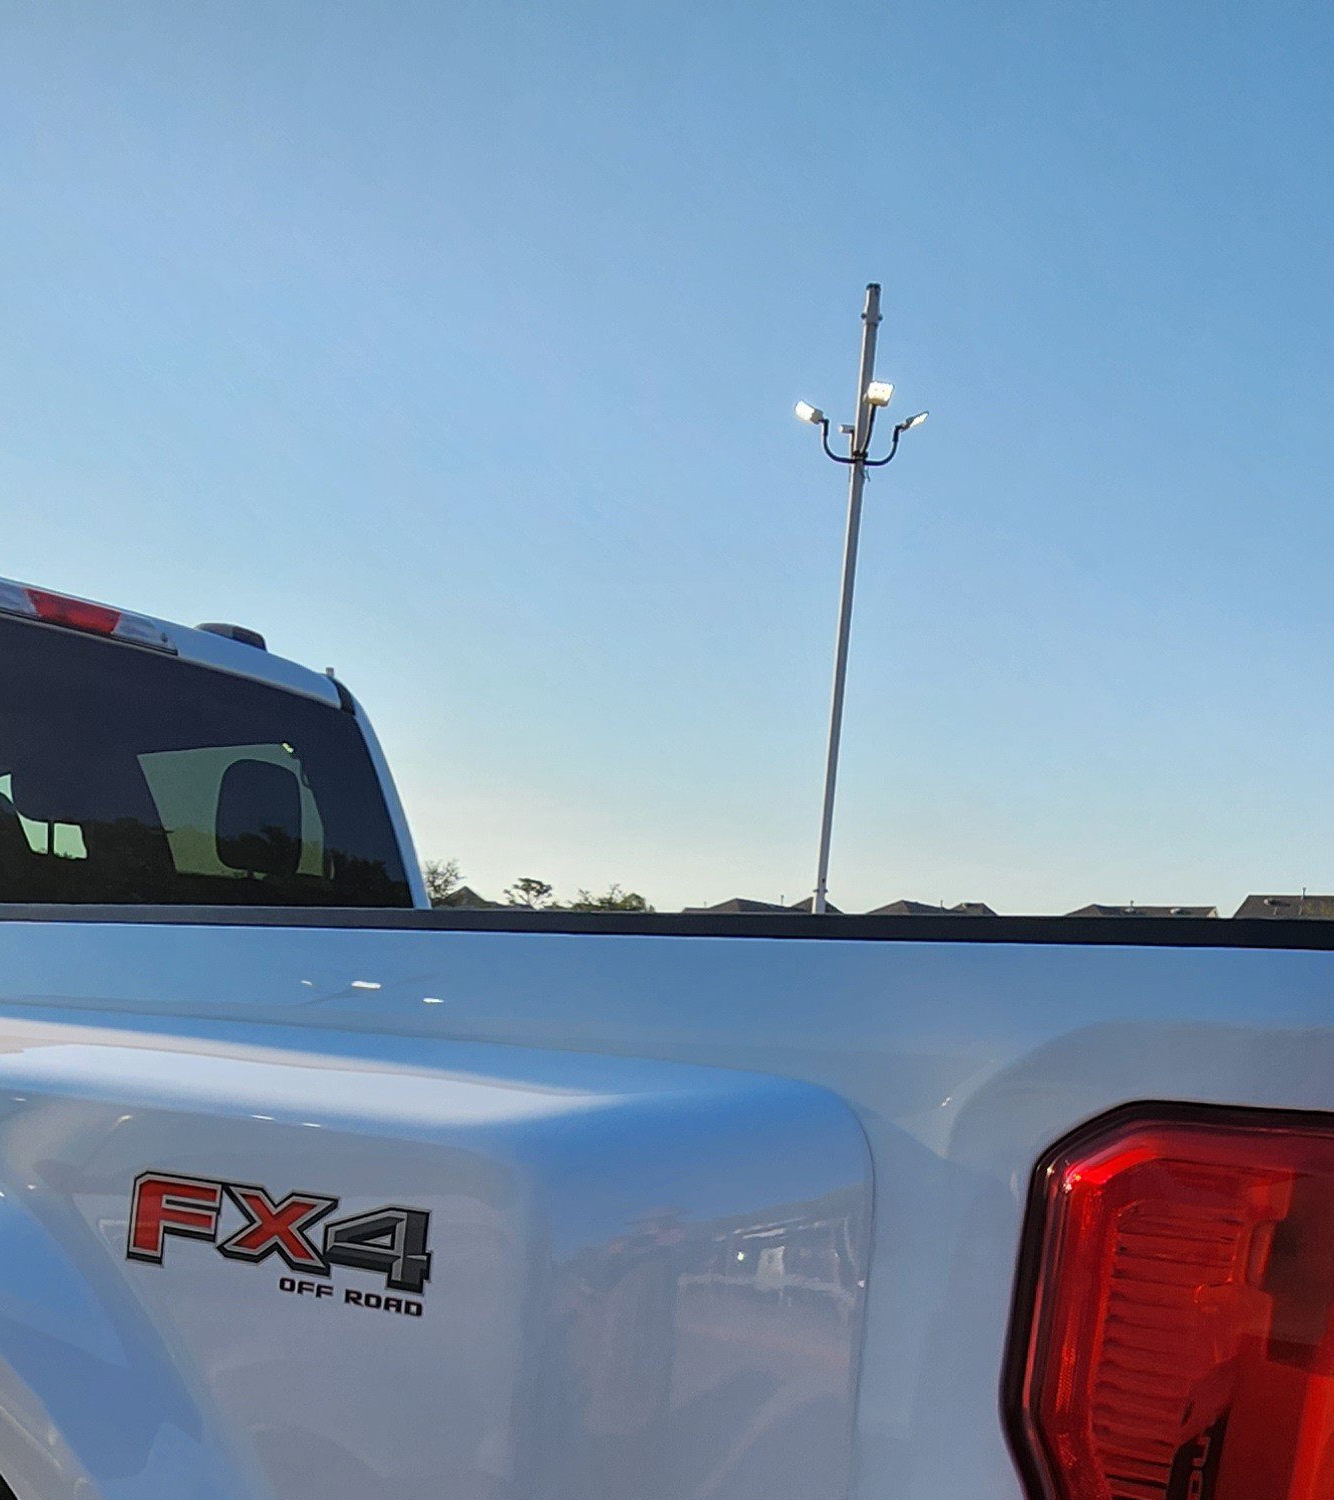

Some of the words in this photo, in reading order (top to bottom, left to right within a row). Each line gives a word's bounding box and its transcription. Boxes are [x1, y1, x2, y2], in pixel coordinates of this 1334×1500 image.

[126, 1171, 431, 1293] FX4
[279, 1277, 333, 1298] OFF
[344, 1289, 423, 1317] ROAD
